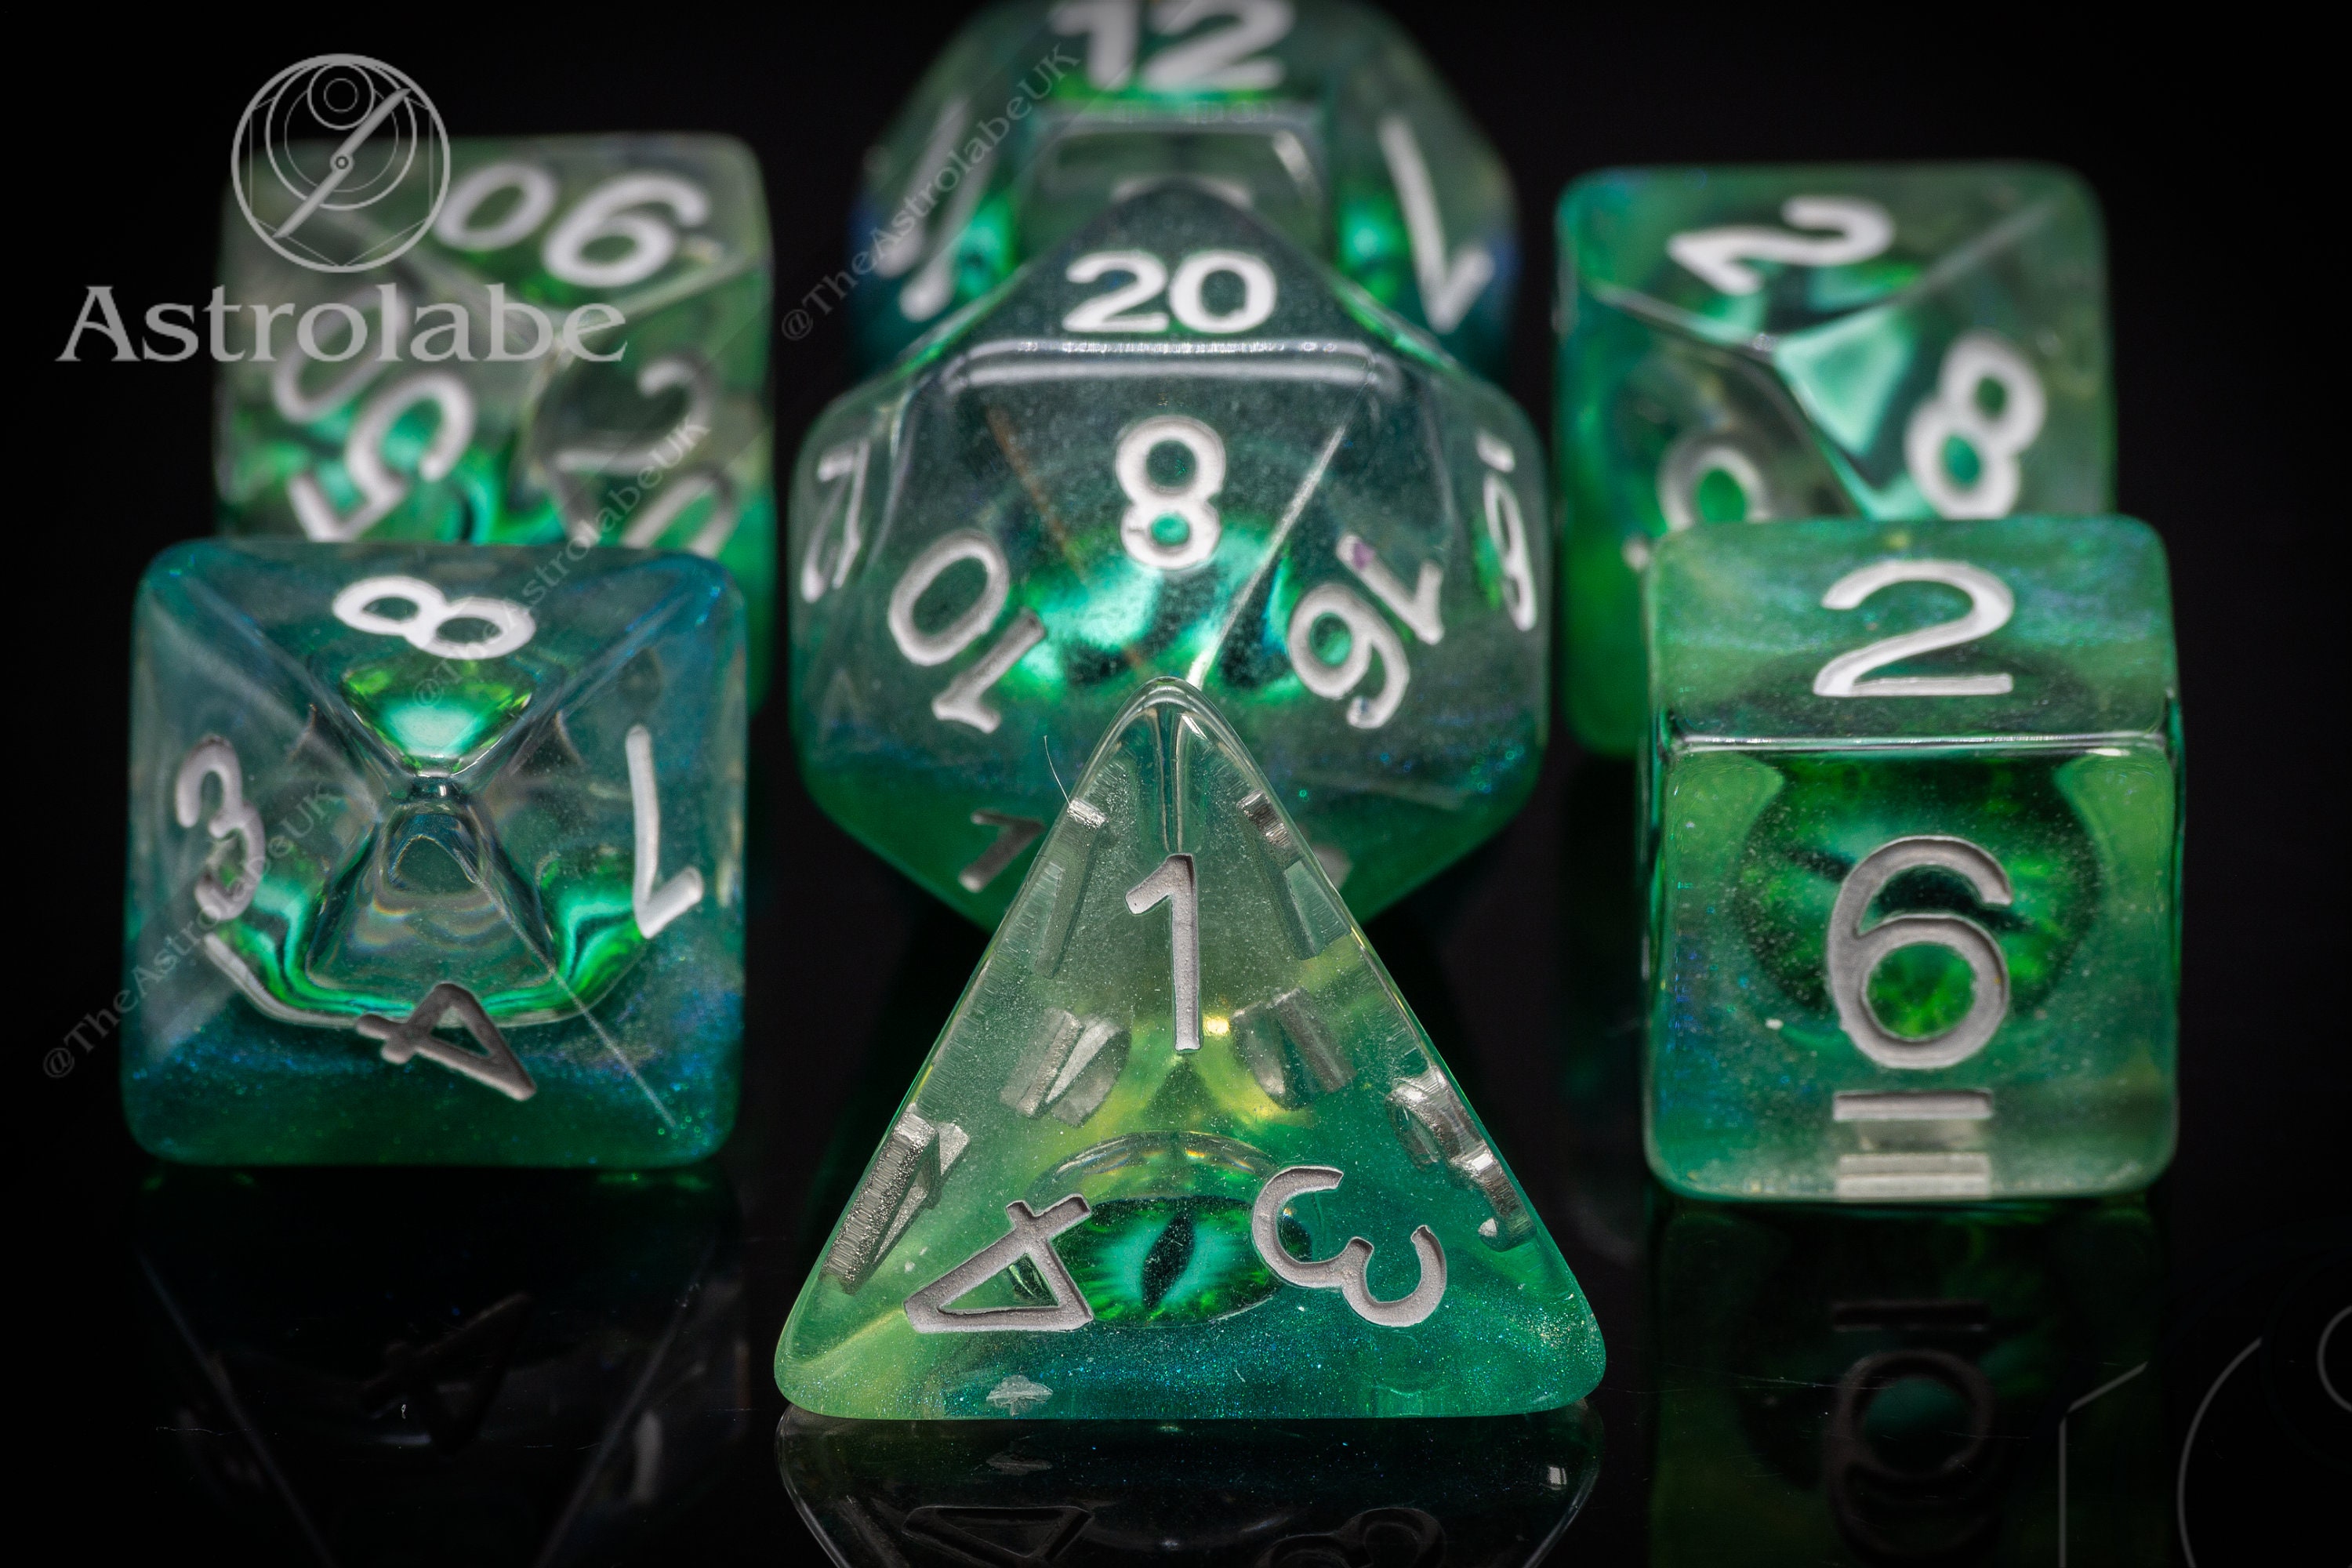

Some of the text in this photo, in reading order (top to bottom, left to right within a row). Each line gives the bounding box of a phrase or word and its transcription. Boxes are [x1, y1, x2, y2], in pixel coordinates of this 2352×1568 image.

[1049, 0, 1292, 93] 12
[1063, 251, 1276, 334] 20
[1667, 196, 1894, 294] 2
[1116, 416, 1225, 570] 8
[1905, 330, 2046, 519] 8
[332, 575, 536, 659] 8
[888, 529, 1045, 733] 10
[1287, 533, 1445, 729] 16
[1813, 560, 2014, 697] 2
[176, 735, 265, 920] 3
[1125, 853, 1202, 1053] 1
[1828, 836, 2013, 1069] 6
[357, 982, 536, 1099] 4
[903, 1194, 1093, 1332] 4
[1252, 1166, 1446, 1327] 3
